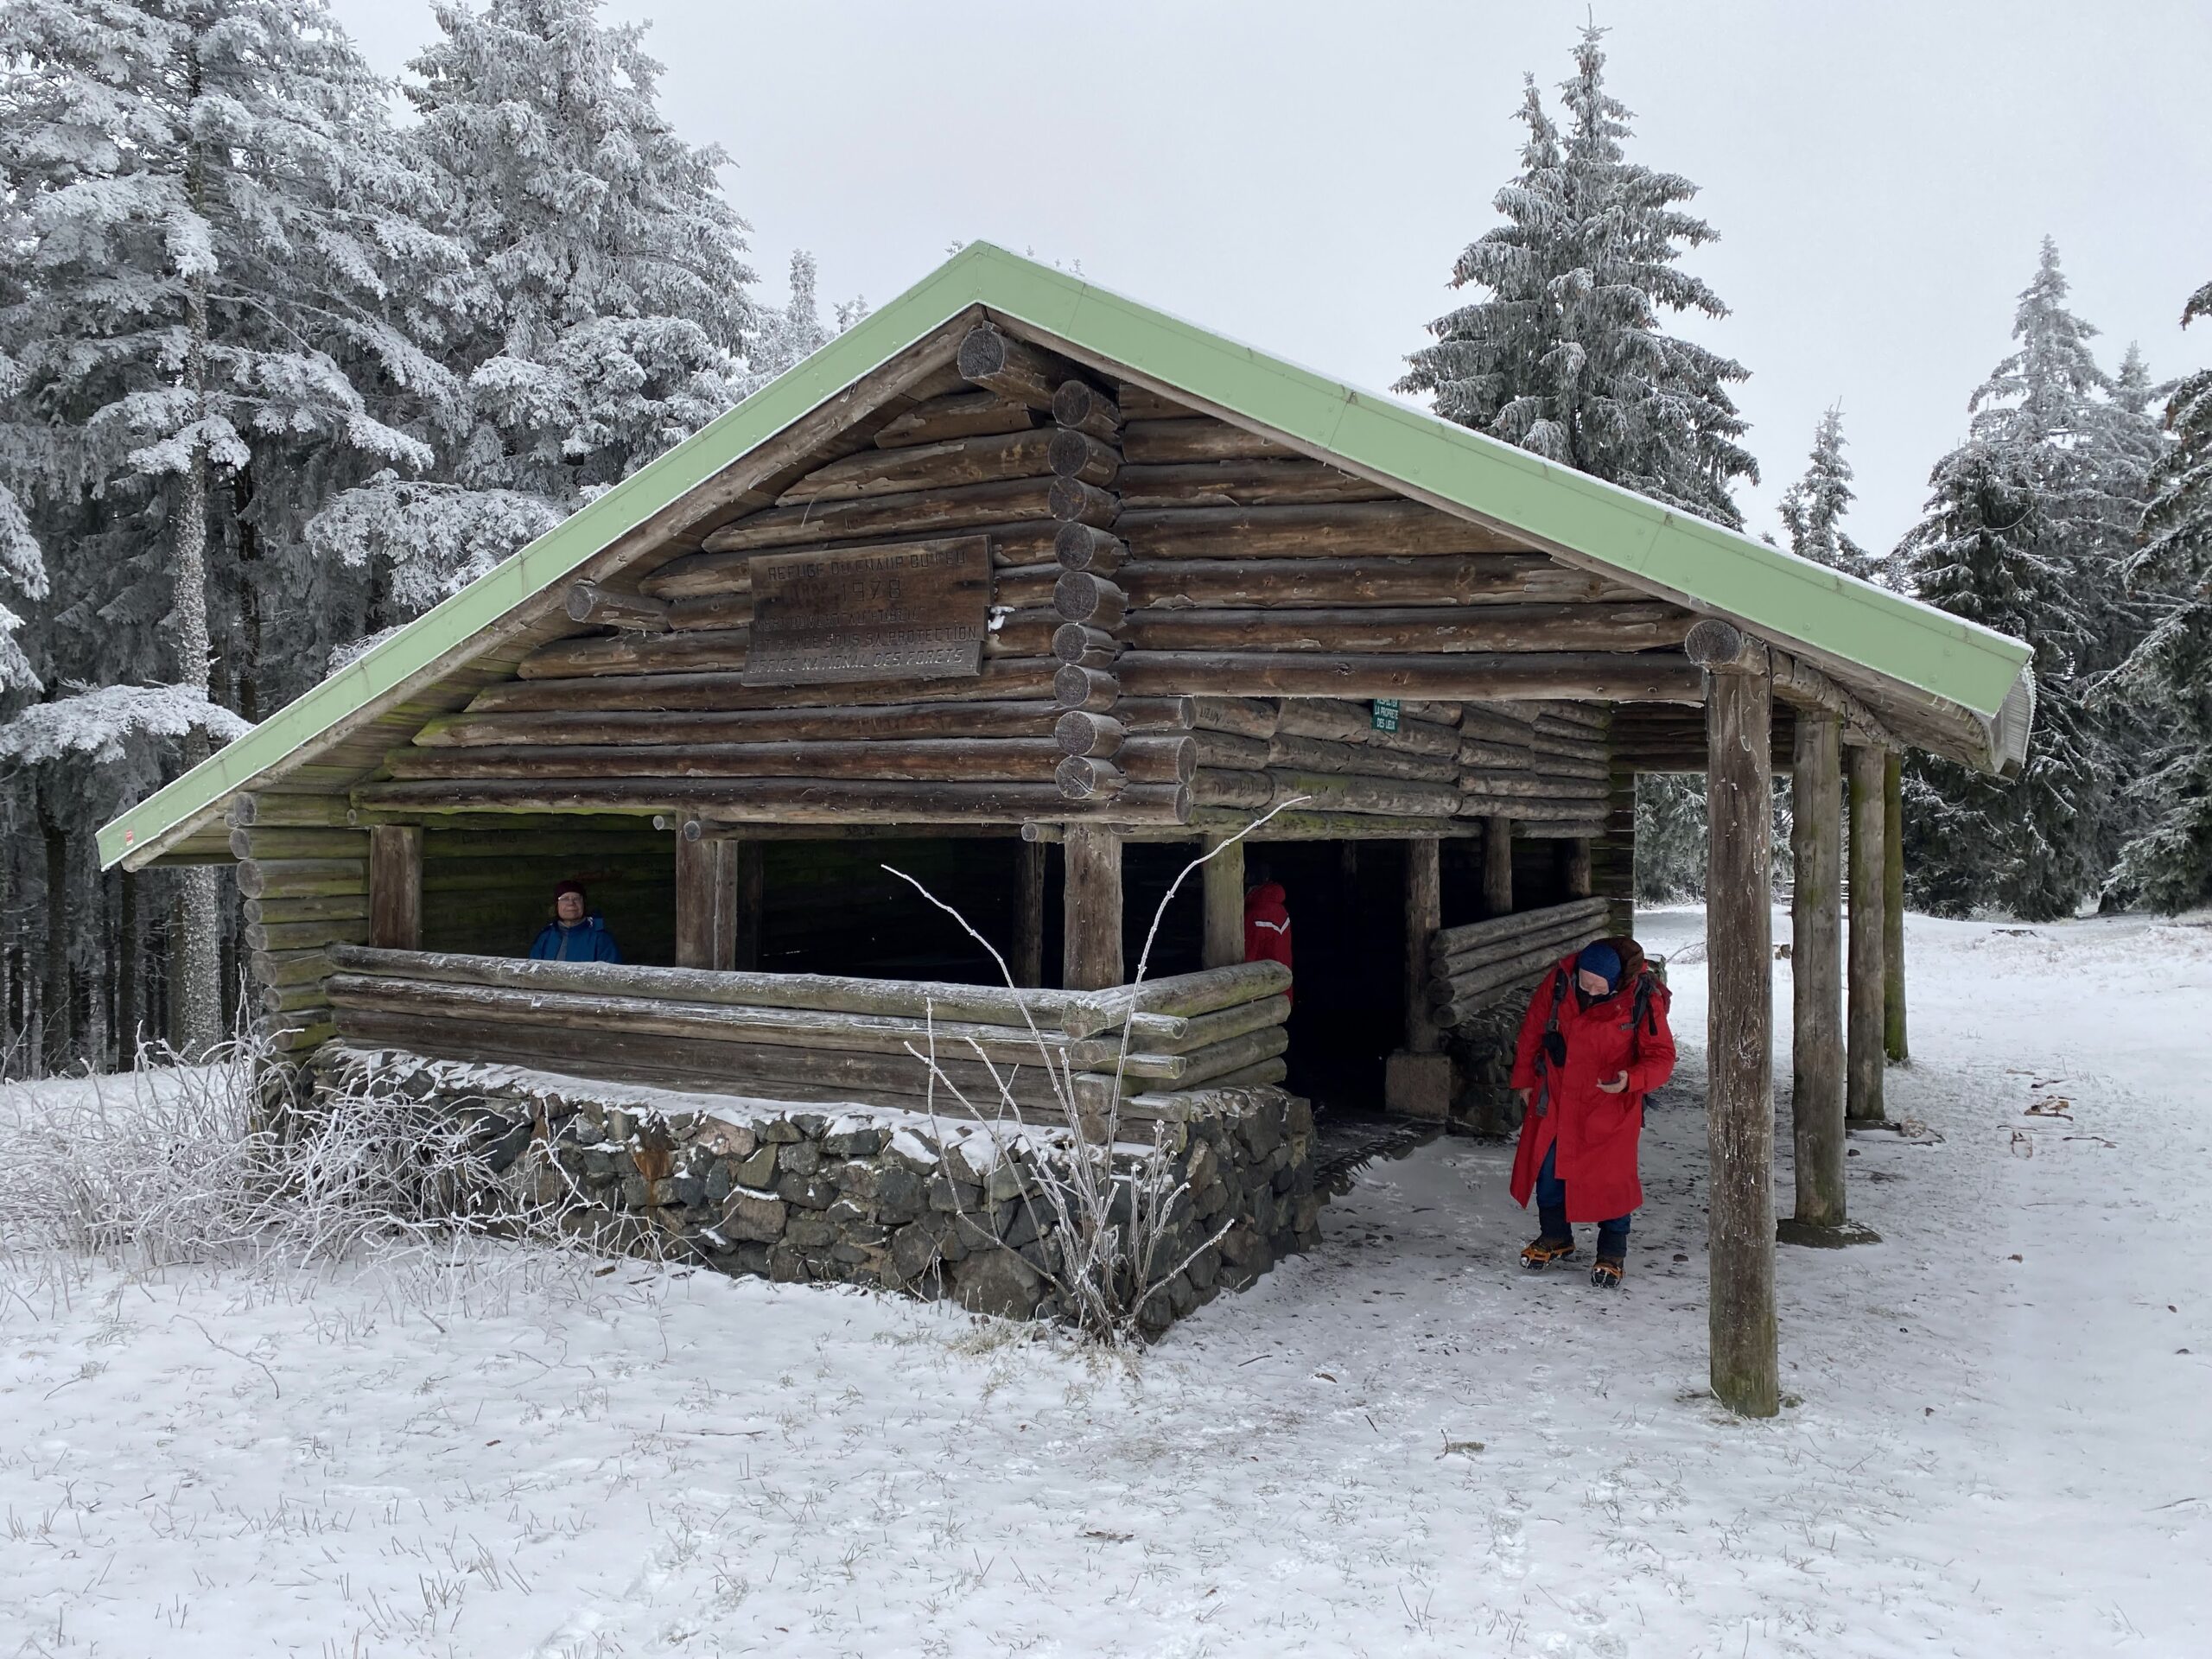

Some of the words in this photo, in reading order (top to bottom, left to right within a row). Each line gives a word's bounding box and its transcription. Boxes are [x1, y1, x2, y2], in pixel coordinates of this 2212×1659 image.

[768, 562, 824, 582] REFUGE
[830, 560, 850, 575] DU
[855, 555, 903, 573] CHAMP
[910, 553, 929, 569] DU
[935, 550, 966, 567] FEU
[842, 579, 902, 602] 1978
[849, 610, 866, 626] AU
[778, 635, 819, 652] PLACE
[825, 632, 861, 649] SOUS
[888, 625, 976, 645] PROTECTION
[748, 657, 798, 675] OFFICE
[801, 652, 868, 672] NATIONAL
[874, 651, 900, 668] DES
[906, 647, 964, 666] FORETS
[1375, 705, 1380, 715] LA
[1376, 717, 1385, 728] DES
[1385, 720, 1395, 730] LIEUX
